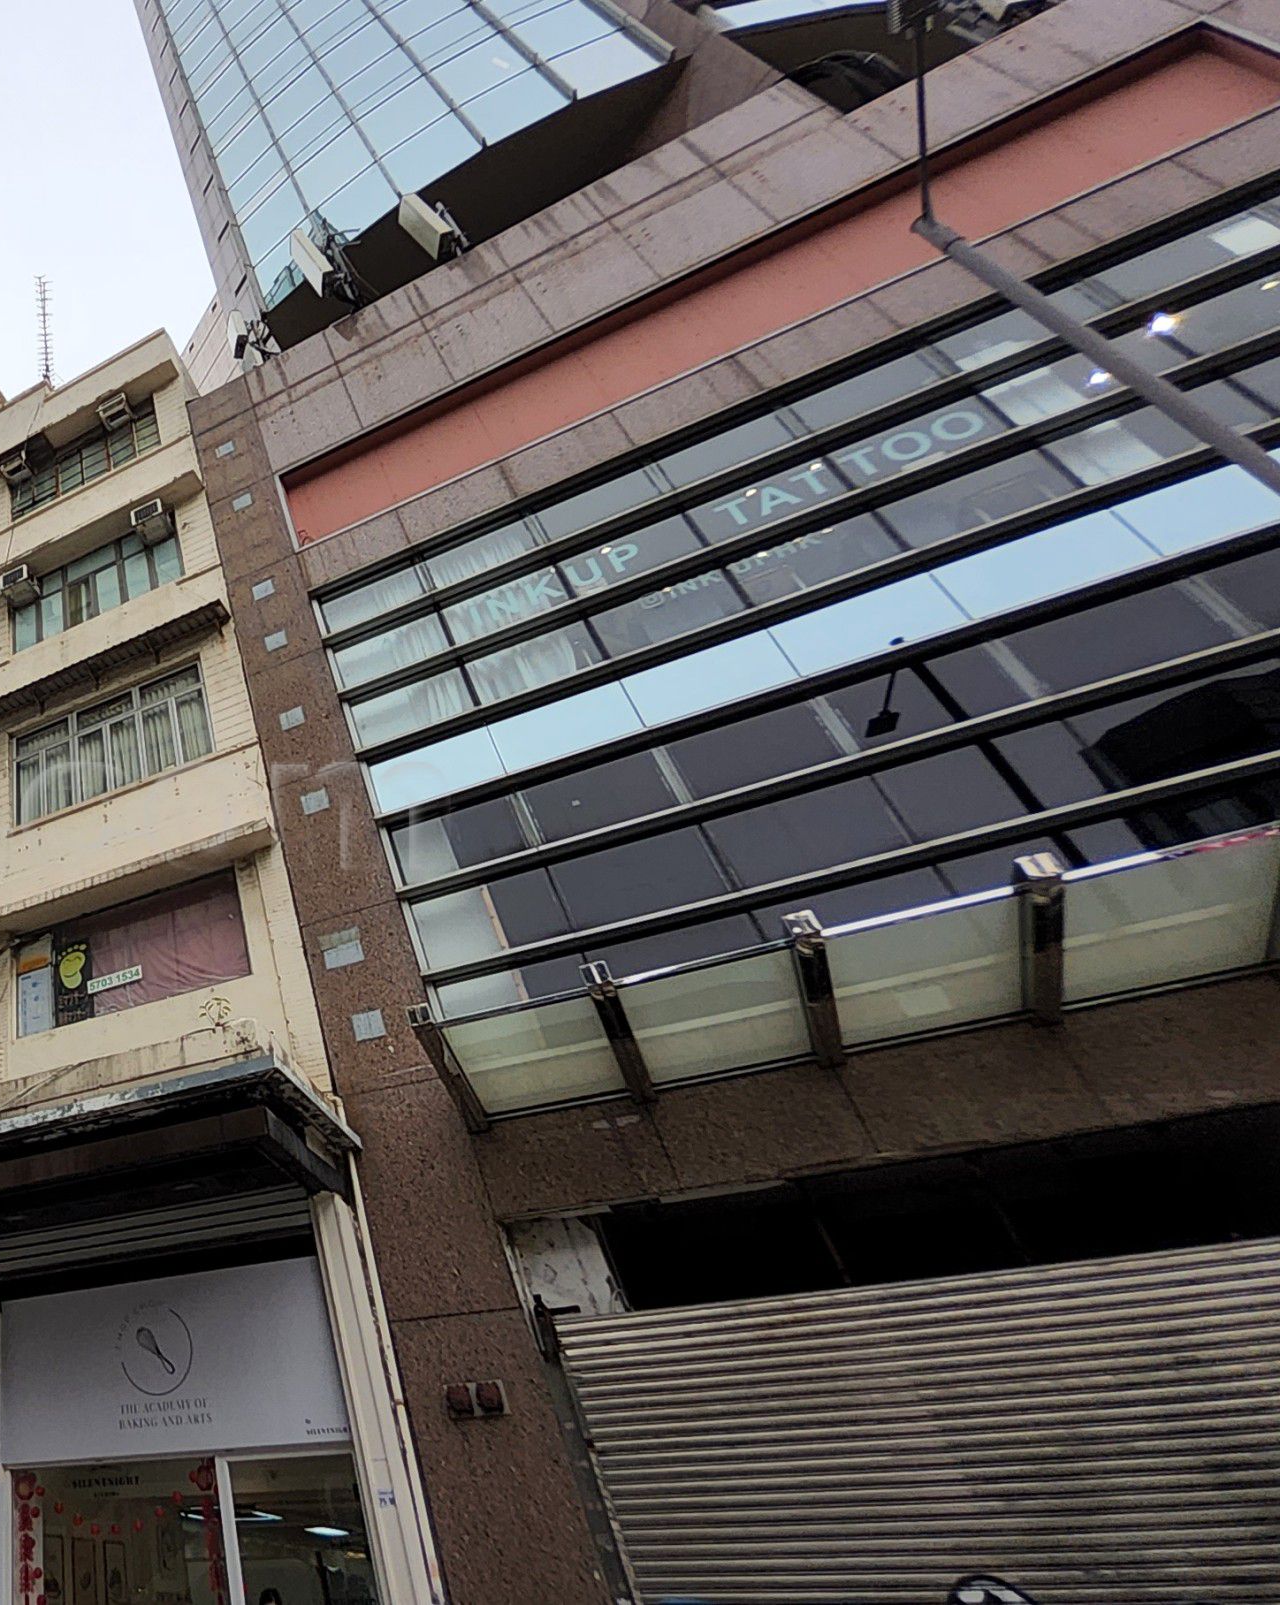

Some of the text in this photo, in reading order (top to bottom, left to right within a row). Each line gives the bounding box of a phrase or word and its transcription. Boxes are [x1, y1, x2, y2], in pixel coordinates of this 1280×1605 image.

[468, 410, 985, 624] INKUP TATTOO
[88, 968, 141, 992] 5703 1534
[120, 1397, 208, 1415] THE ACADEMY OF
[118, 1412, 213, 1430] BAKING AND ARTS
